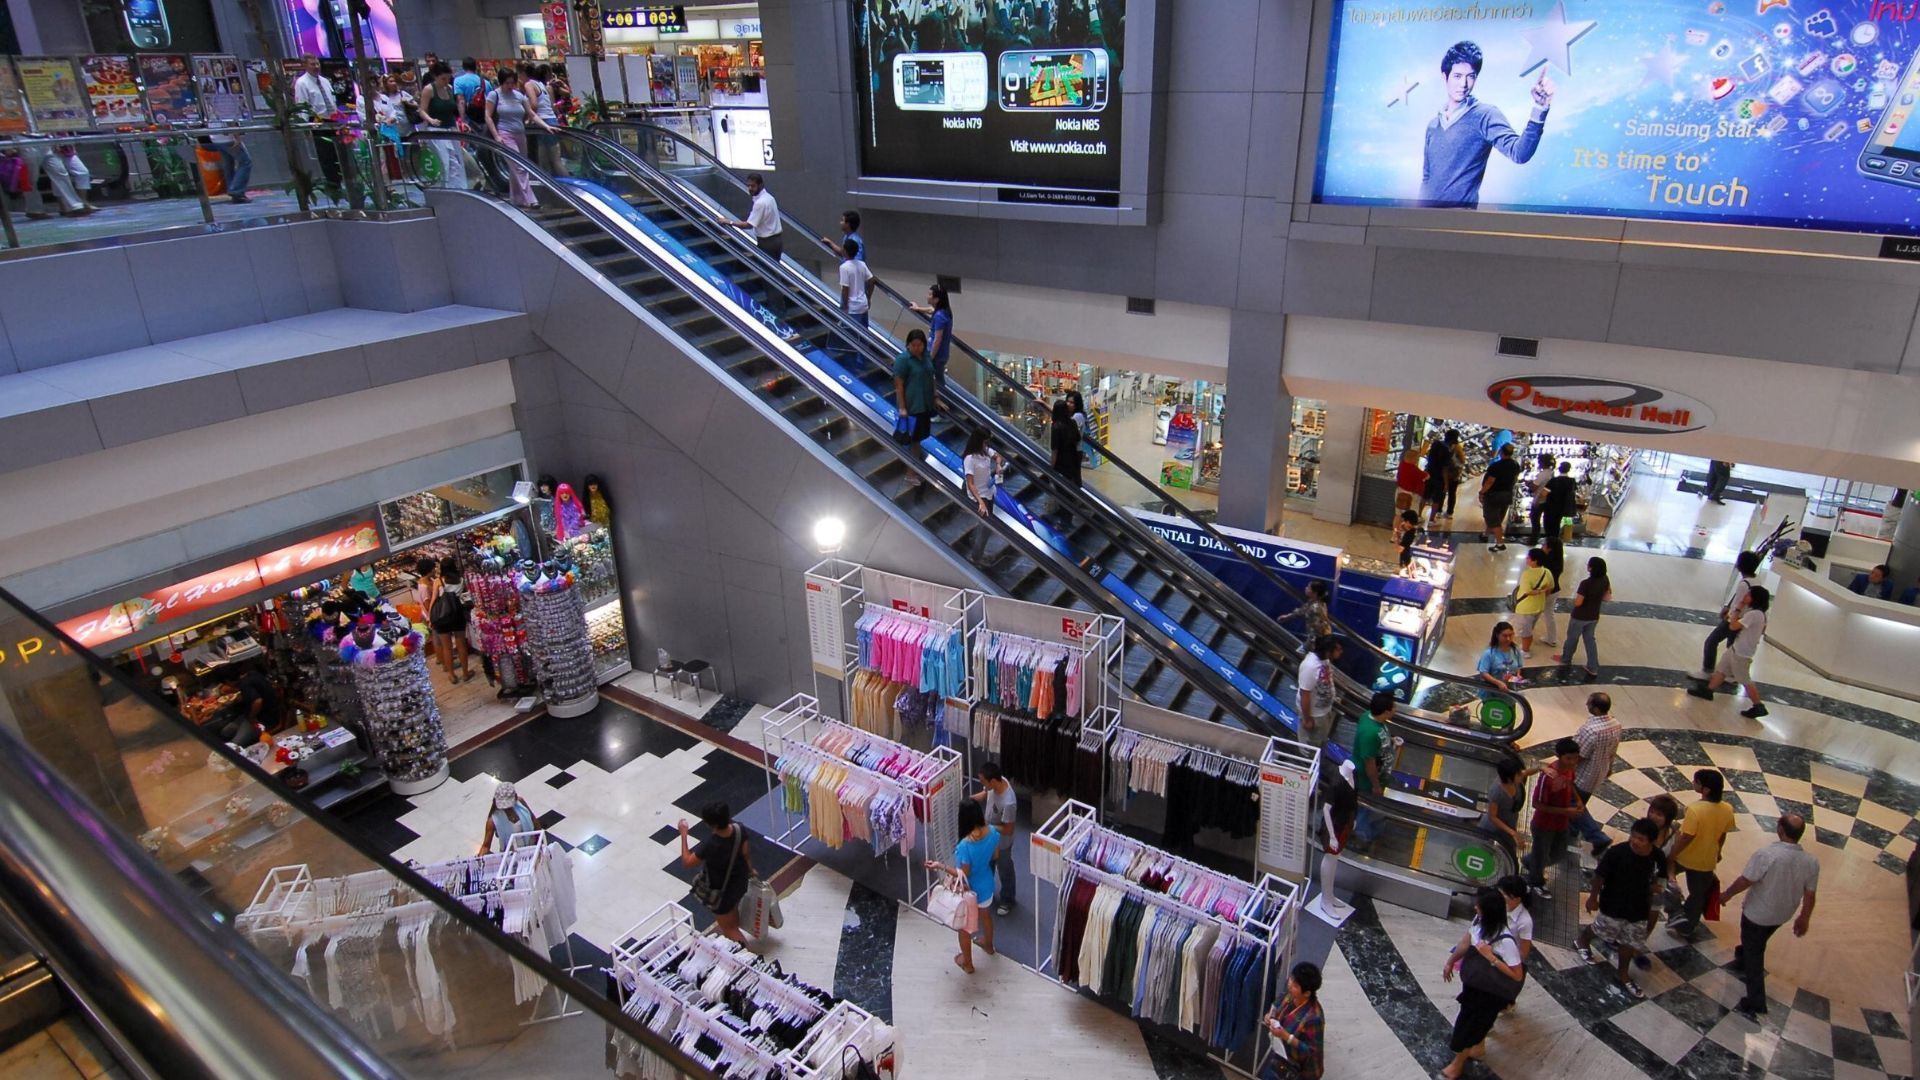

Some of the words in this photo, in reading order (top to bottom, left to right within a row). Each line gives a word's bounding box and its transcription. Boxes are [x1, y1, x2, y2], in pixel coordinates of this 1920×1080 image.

[943, 118, 965, 129] Nokia
[967, 118, 982, 129] N79
[1055, 118, 1080, 130] Nokia
[1082, 119, 1100, 131] N85
[1625, 119, 1711, 143] Samsung
[1716, 120, 1756, 138] Star
[1010, 140, 1028, 153] Visit
[1030, 140, 1107, 155] www.nokia.co.th
[1570, 148, 1609, 168] It's
[1617, 149, 1666, 170] time
[1675, 152, 1702, 171] to
[1647, 174, 1749, 207] Touch
[1487, 379, 1634, 418] Phayathai
[1640, 406, 1690, 426] Hall
[1199, 535, 1267, 558] DIAOND
[184, 568, 267, 606] House
